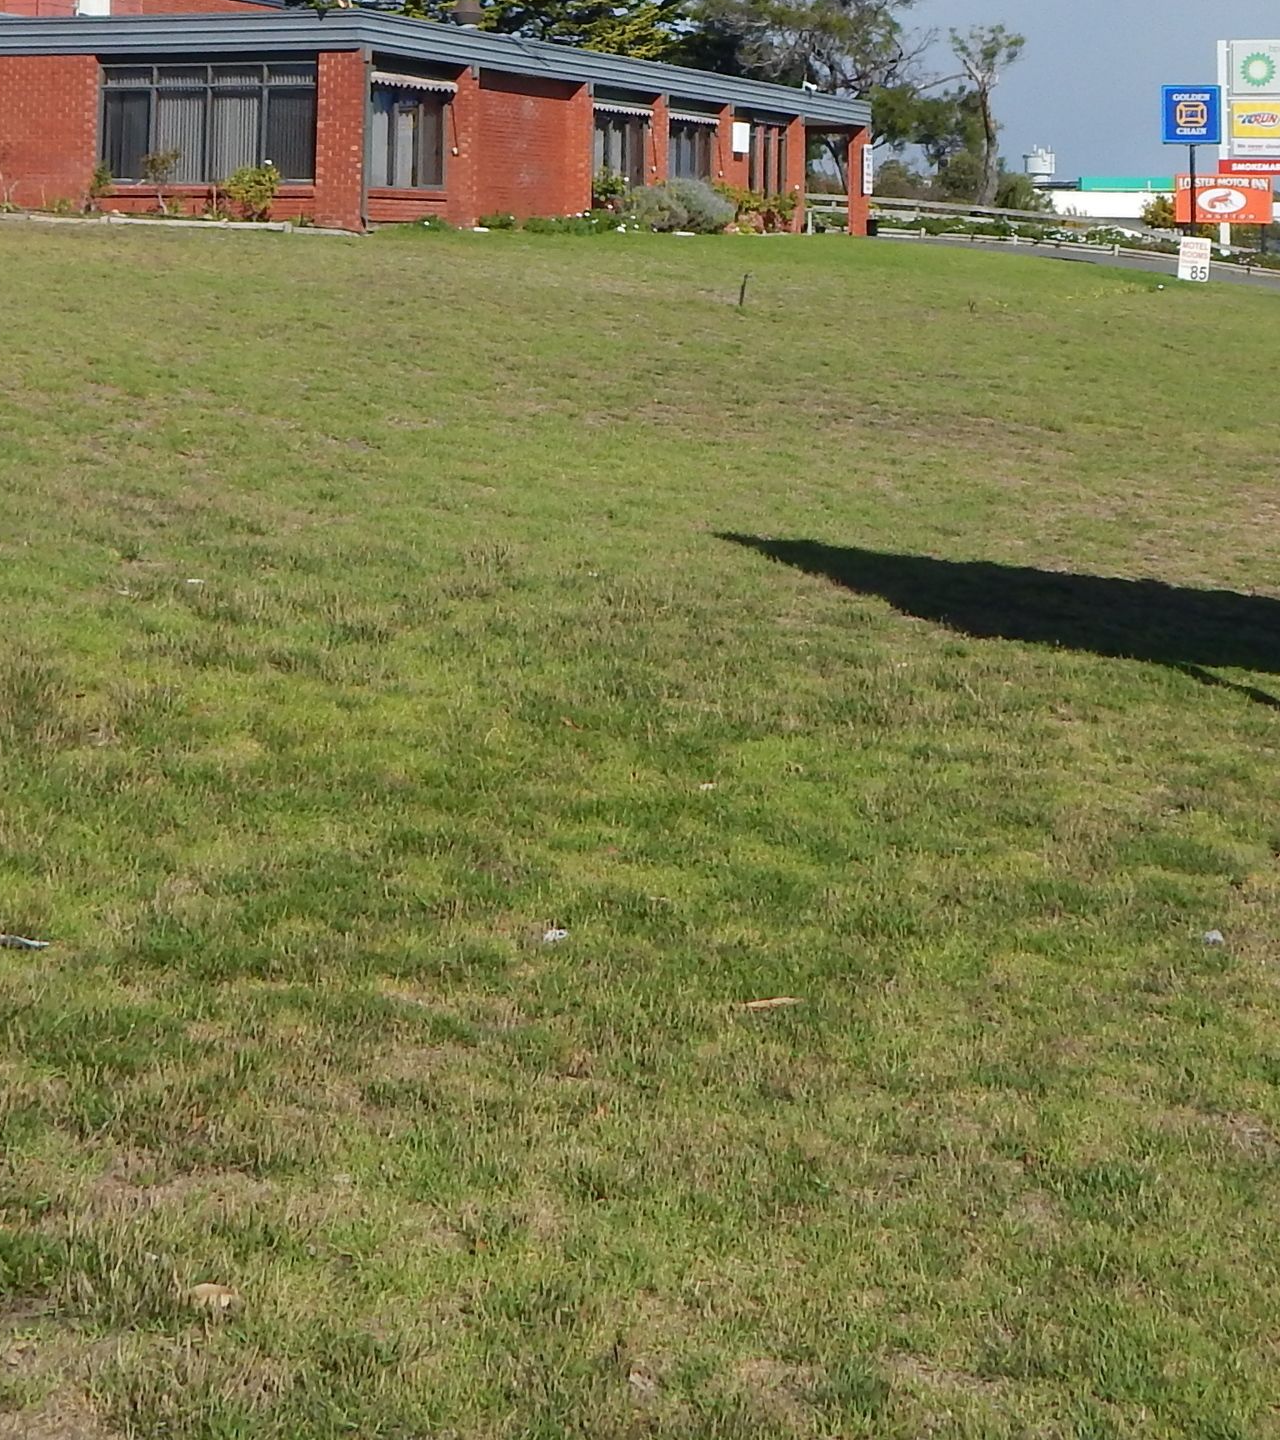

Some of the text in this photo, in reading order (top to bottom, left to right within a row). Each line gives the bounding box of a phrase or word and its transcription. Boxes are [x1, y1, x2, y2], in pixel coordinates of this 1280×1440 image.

[1172, 93, 1211, 101] GOLDEN
[1175, 127, 1208, 135] CHAIN
[1179, 178, 1269, 191] LOSTER MOTOR INN
[1183, 241, 1209, 251] MOTEL
[1181, 250, 1209, 260] ROOMS
[1190, 265, 1207, 280] 85
